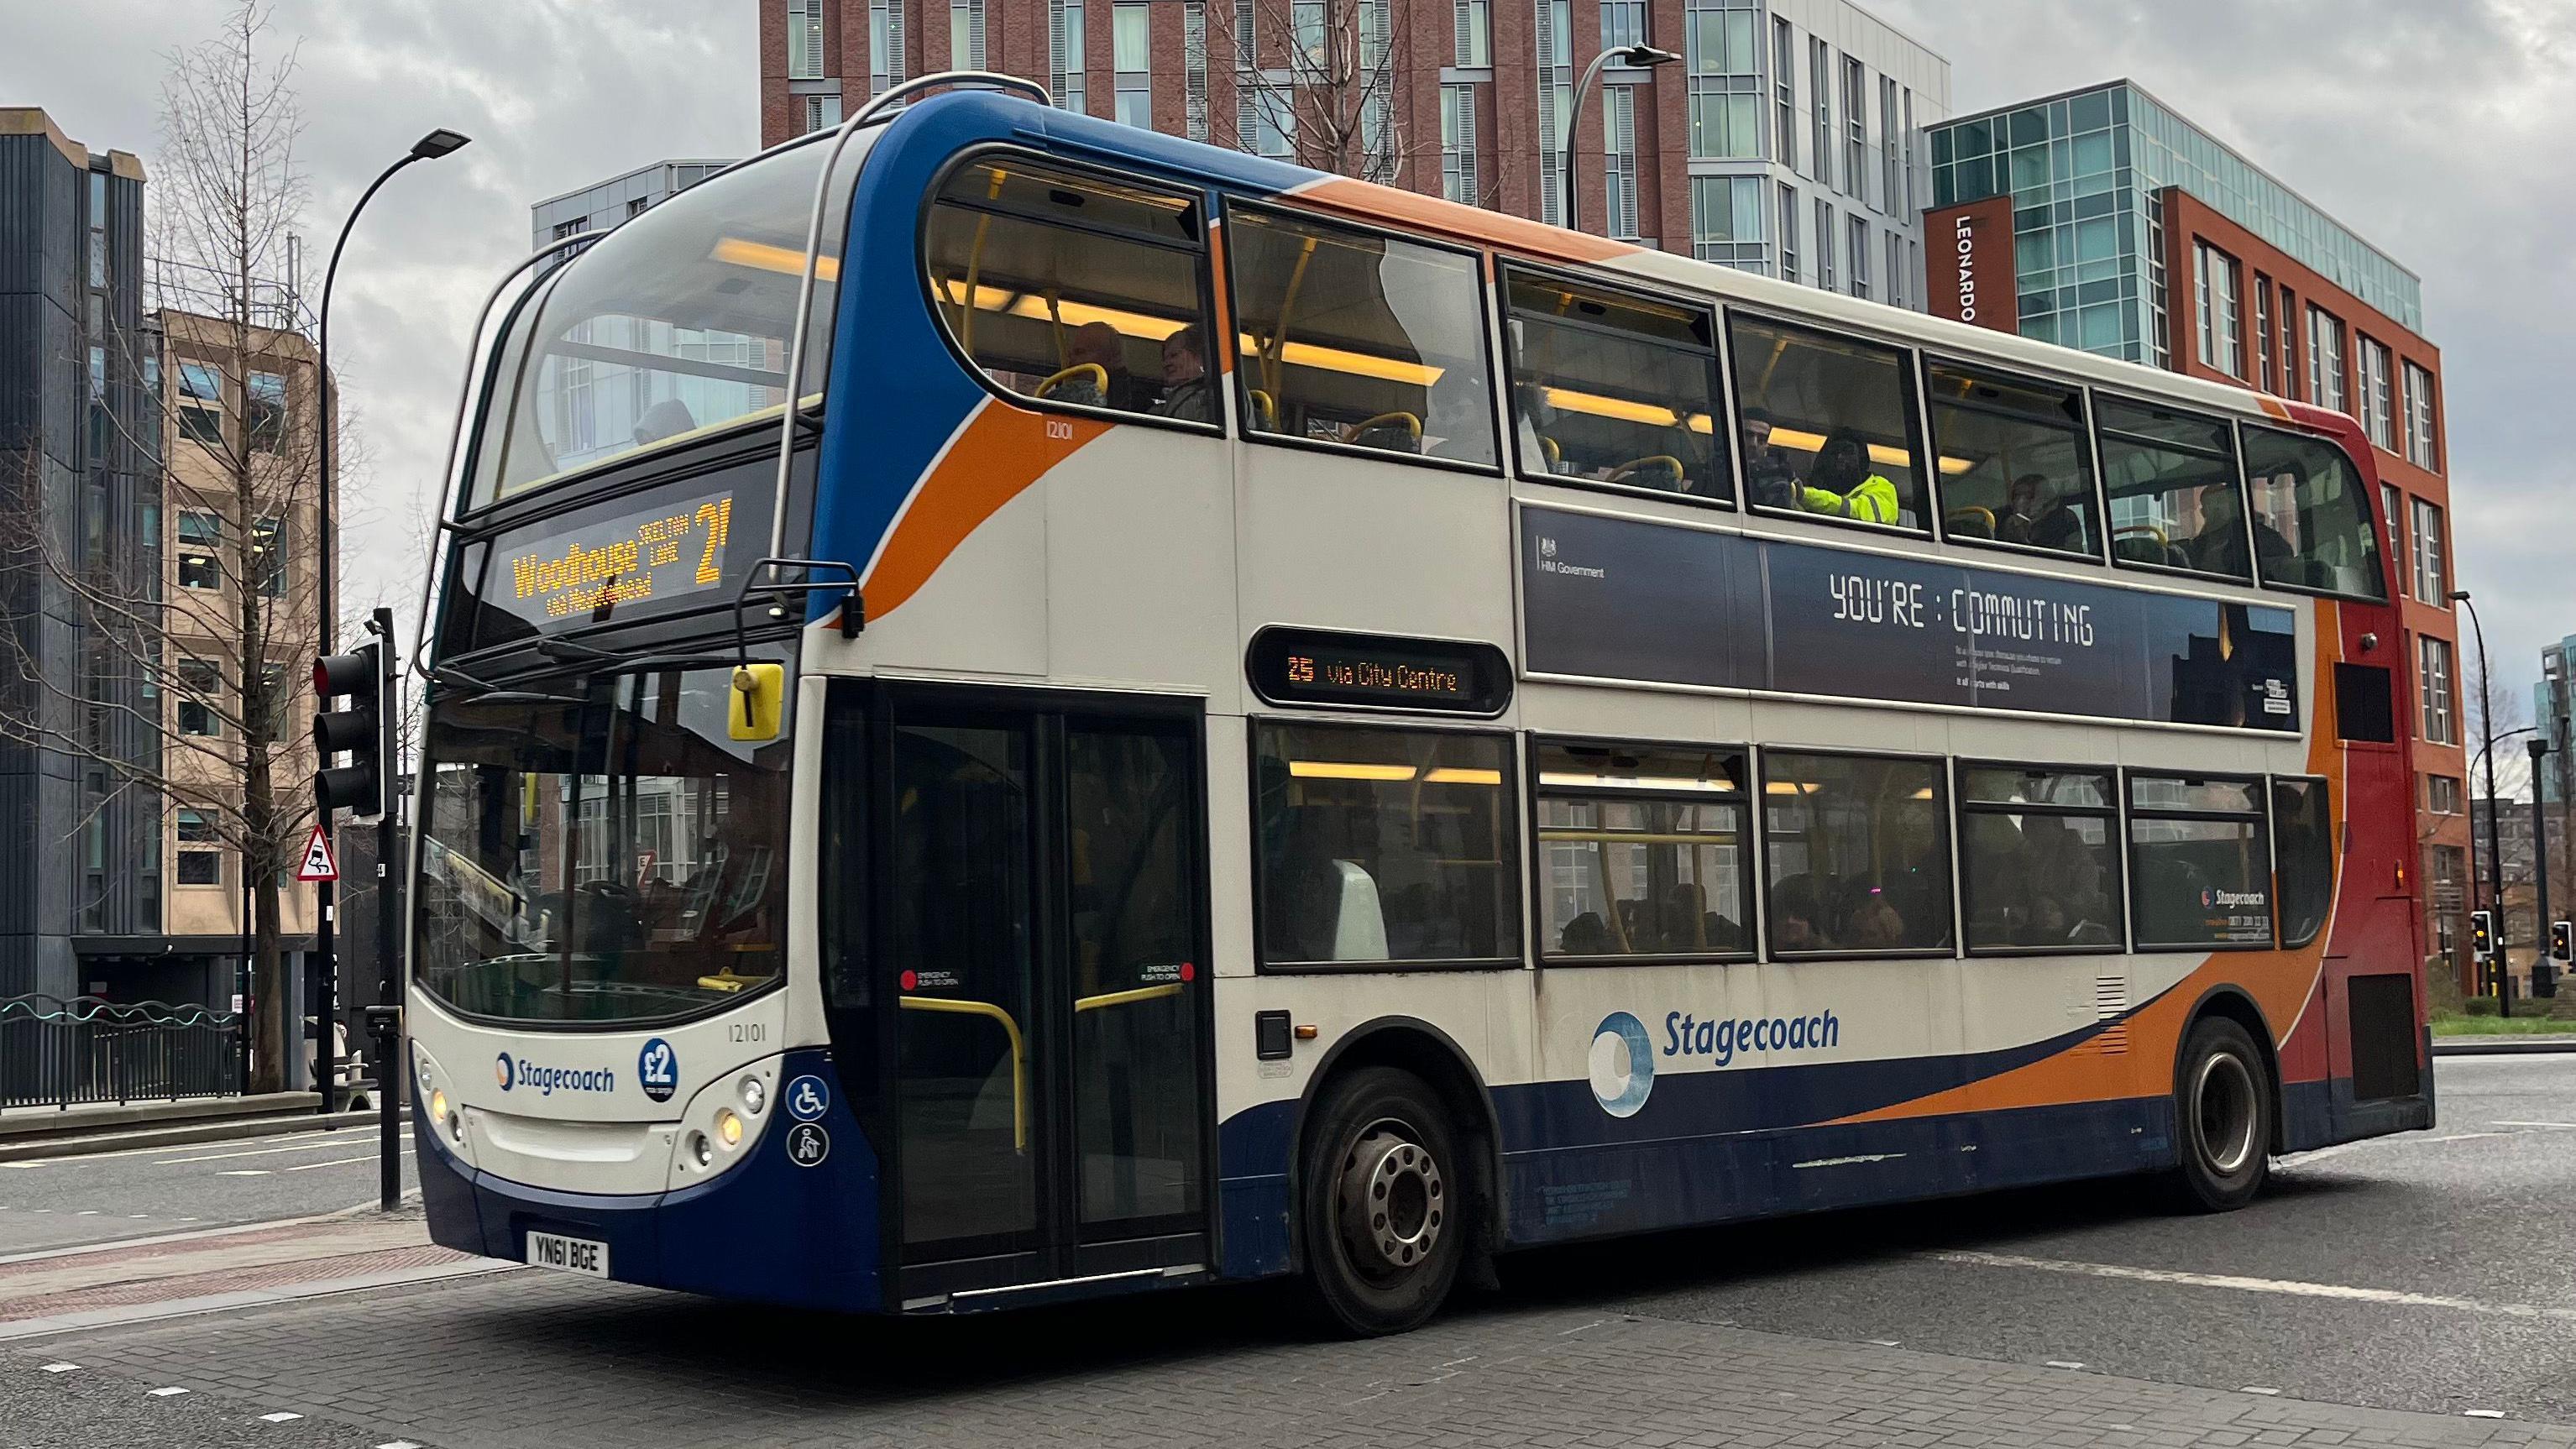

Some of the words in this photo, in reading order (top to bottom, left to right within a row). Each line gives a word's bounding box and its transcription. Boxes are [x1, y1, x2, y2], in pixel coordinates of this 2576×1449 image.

[1956, 216, 1976, 322] LEONARDO
[511, 539, 638, 599] Woodhouse
[1542, 560, 1556, 572] HM
[1558, 562, 1605, 578] Government
[1830, 573, 1924, 628] YOU'RE
[1952, 588, 2093, 646] COMMUTING
[1288, 656, 1313, 683] 25
[1327, 661, 1353, 685] via
[1358, 662, 1392, 688] City
[1398, 665, 1457, 692] Centre
[2216, 889, 2264, 909] Stagecoach
[728, 1023, 767, 1044] 12101
[1663, 1008, 1839, 1066] Stagecoach
[517, 1059, 615, 1096] Stagecoach
[645, 1044, 672, 1083] £2
[536, 1235, 568, 1267] YN61
[569, 1242, 599, 1273] BGE
